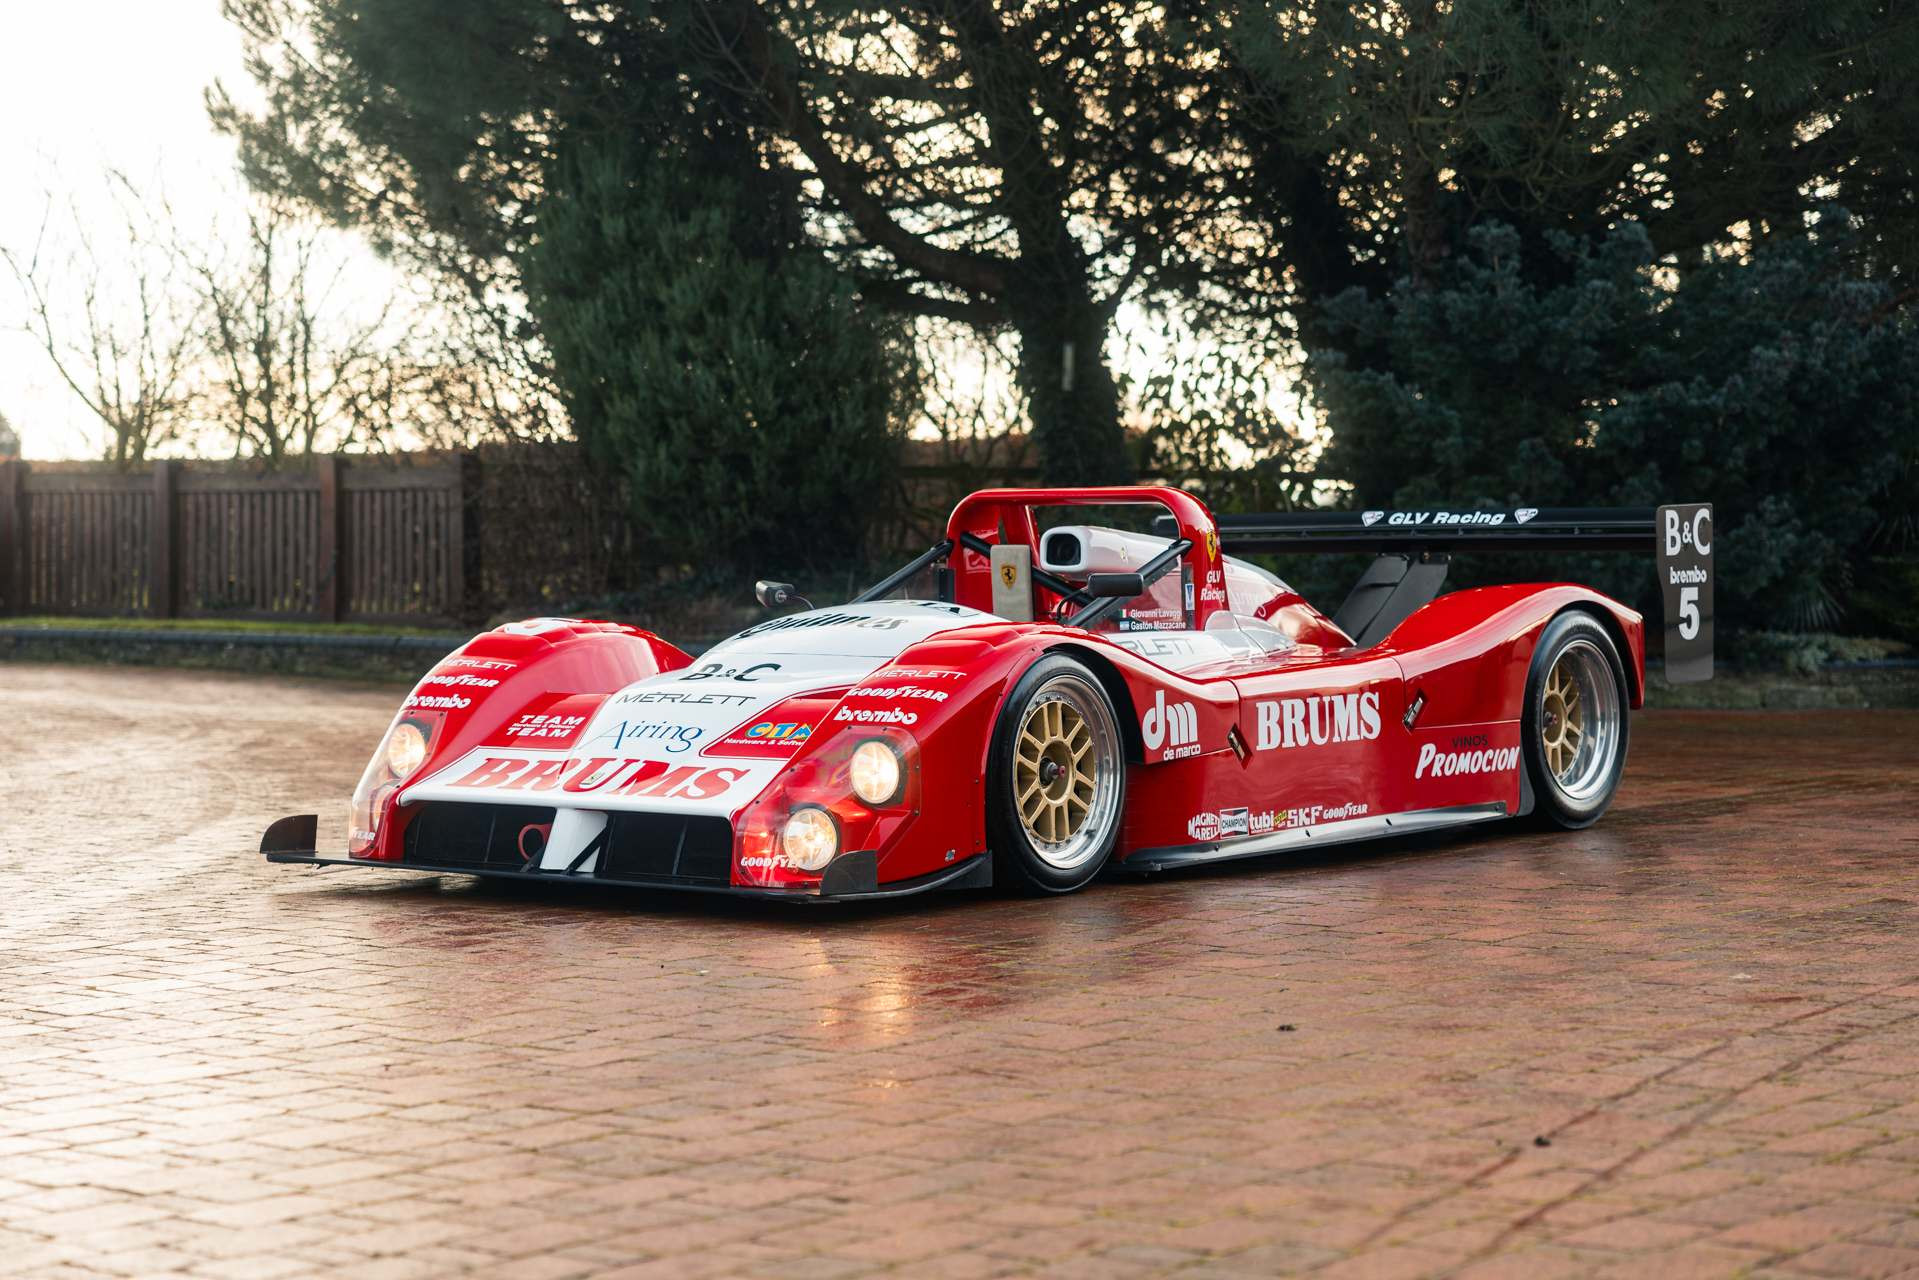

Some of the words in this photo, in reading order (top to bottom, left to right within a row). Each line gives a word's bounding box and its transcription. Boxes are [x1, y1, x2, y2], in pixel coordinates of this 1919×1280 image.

[1388, 512, 1430, 525] GLV
[1432, 511, 1506, 526] Racing
[1665, 508, 1711, 556] B&C
[1206, 571, 1221, 584] GLV
[1670, 565, 1707, 584] brembo
[1200, 588, 1225, 602] Racing
[1678, 587, 1700, 640] 5
[679, 663, 782, 681] B&C
[874, 669, 967, 680] MERLETT
[615, 692, 757, 706] MERLETT
[847, 685, 949, 702] GOODYEAR
[520, 714, 586, 725] TEAM
[832, 705, 918, 725] brembo
[1255, 692, 1381, 752] BRUMS
[506, 727, 572, 738] TEAM
[580, 720, 706, 753] Airing
[1451, 734, 1489, 749] VINOS
[1163, 746, 1175, 761] de
[1175, 743, 1201, 759] marco
[445, 757, 750, 801] BRUMS
[1249, 810, 1274, 830] tubi
[1287, 805, 1322, 828] SKF
[1323, 802, 1368, 820] GOODYEAR
[1222, 817, 1247, 830] CHAMPION
